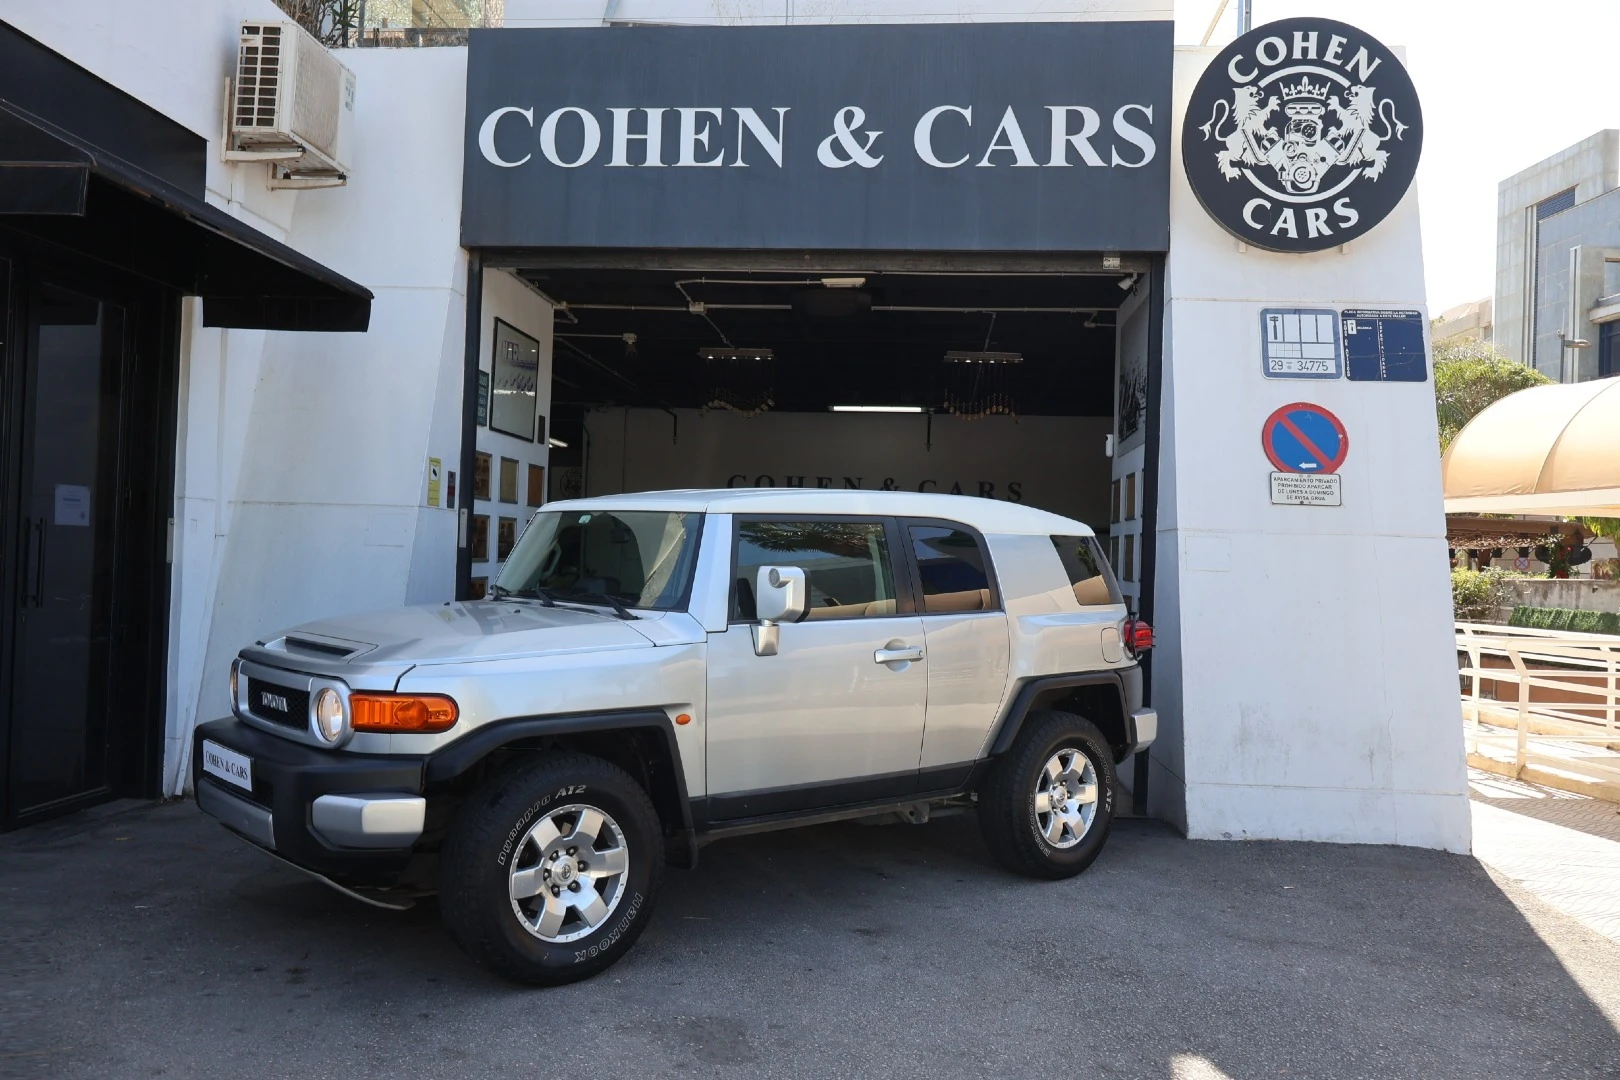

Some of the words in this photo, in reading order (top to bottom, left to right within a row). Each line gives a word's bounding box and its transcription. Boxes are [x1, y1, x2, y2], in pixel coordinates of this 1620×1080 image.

[1227, 31, 1382, 83] COHEN
[478, 106, 791, 168] COHEN
[816, 105, 884, 168] &
[914, 104, 1156, 168] CARS
[1242, 197, 1359, 239] CARS
[1270, 360, 1284, 370] 29
[1297, 360, 1329, 371] 34775
[261, 691, 288, 712] TOYOTA
[205, 750, 225, 770] COHEN
[225, 760, 231, 773] &
[231, 762, 248, 780] CARS
[555, 784, 587, 799] AT2
